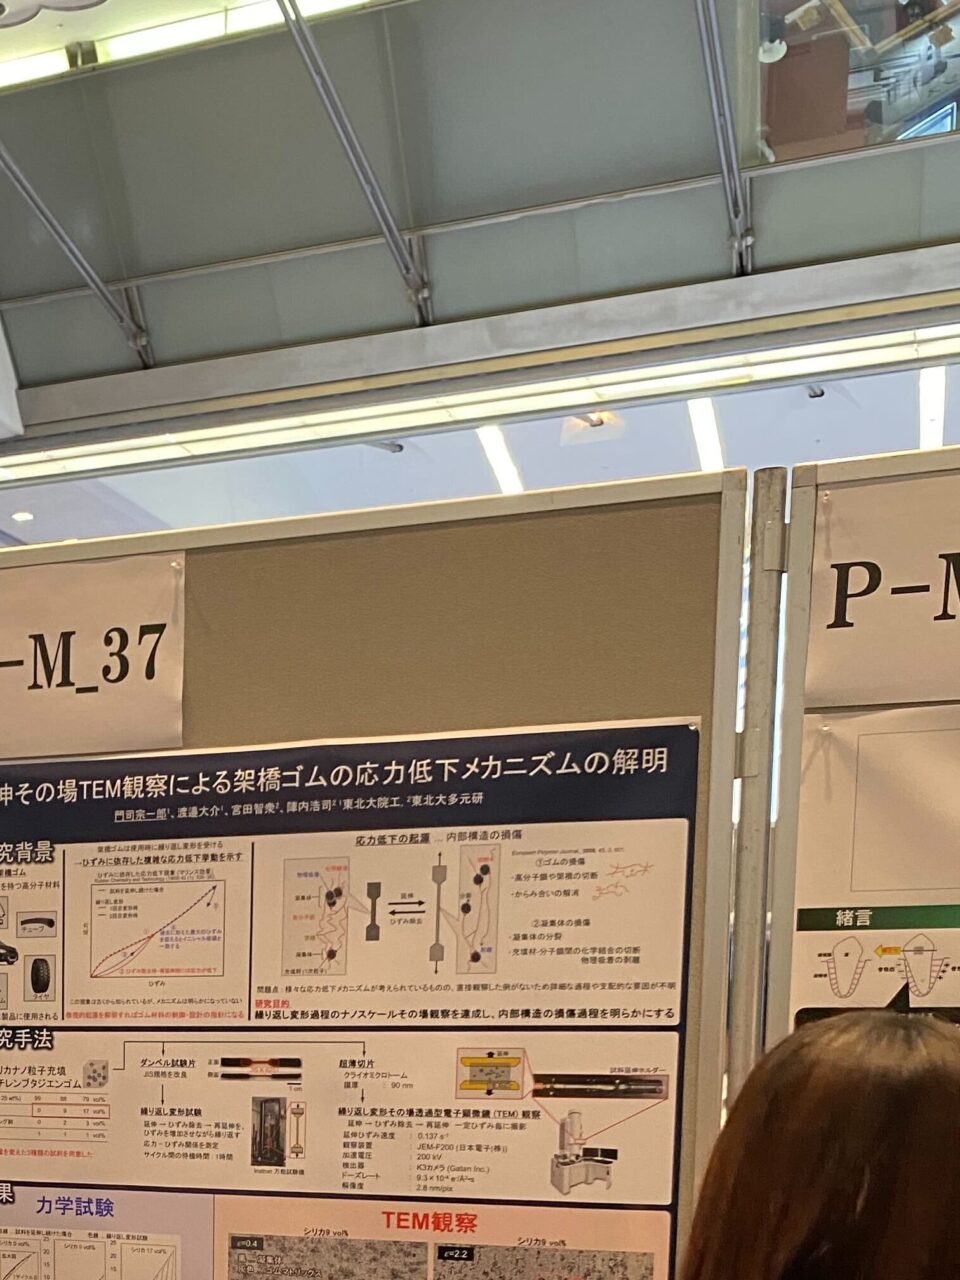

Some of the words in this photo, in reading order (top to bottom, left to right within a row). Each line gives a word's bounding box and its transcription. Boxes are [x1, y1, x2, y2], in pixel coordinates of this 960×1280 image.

[355, 833, 430, 846] 応力低下の起源
[446, 830, 522, 842] 内部構造の損傷
[836, 909, 873, 927] 緒言
[255, 1000, 289, 1008] 研究目的
[140, 1059, 196, 1068] ダンベル試験片
[140, 1107, 202, 1117] 繰り返し変形試験
[522, 1111, 541, 1119] 観察
[36, 1196, 114, 1217] 力学試験
[381, 1210, 478, 1234] TEM観察
[444, 1250, 468, 1258] ε=2.2
